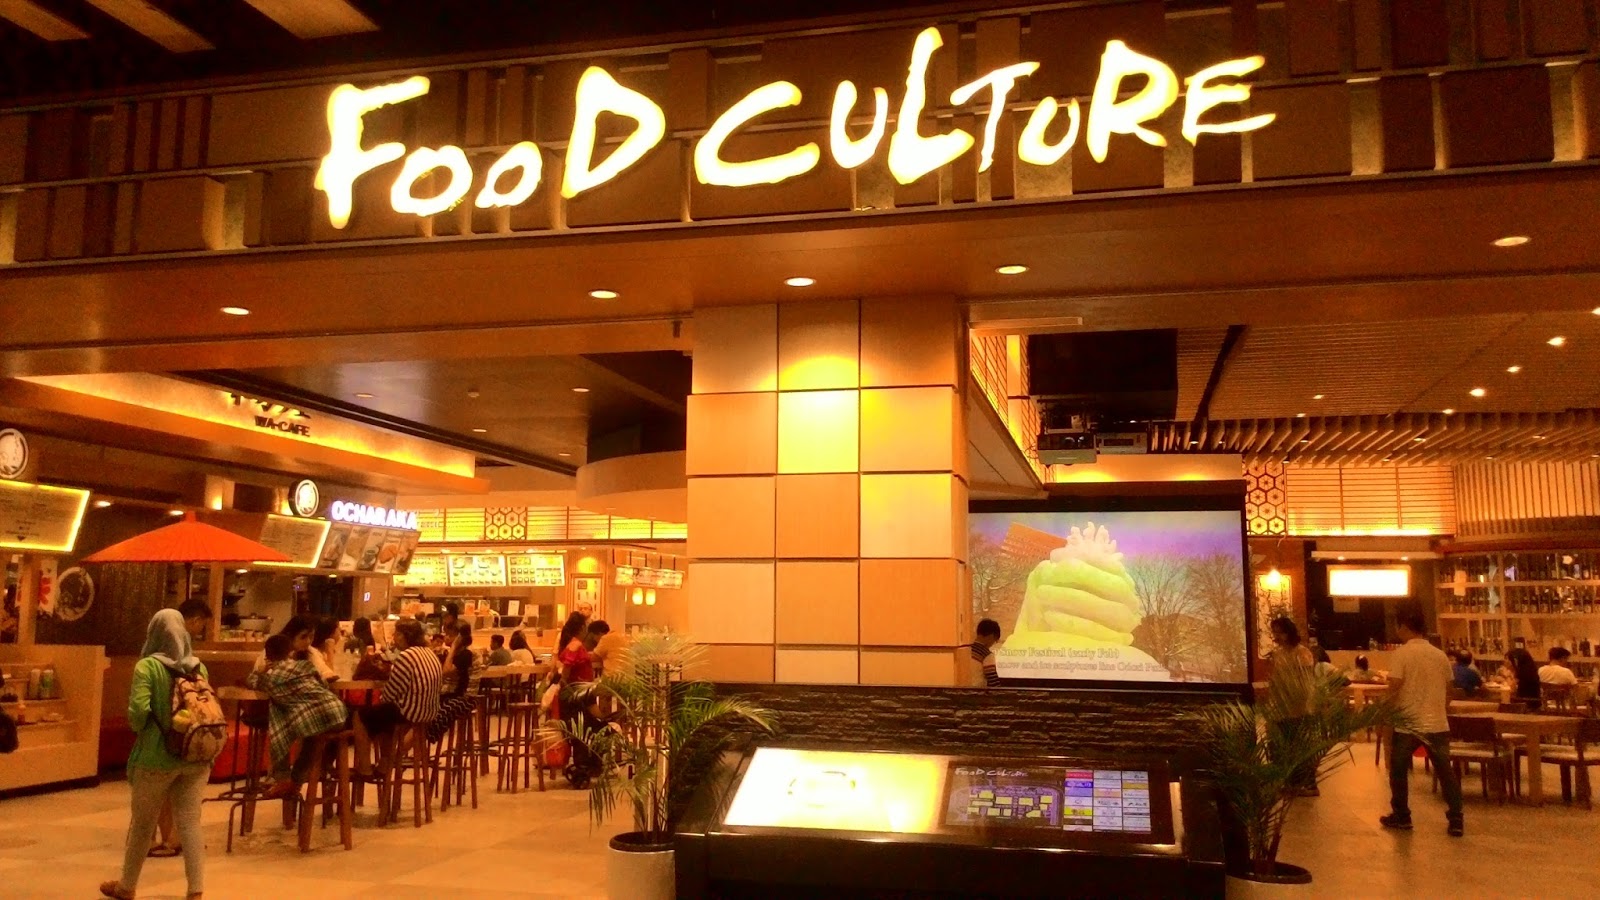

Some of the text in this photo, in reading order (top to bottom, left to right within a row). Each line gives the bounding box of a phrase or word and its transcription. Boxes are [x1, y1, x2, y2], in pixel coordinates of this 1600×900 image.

[254, 415, 311, 438] WA-CAFE
[331, 500, 417, 530] OCHARAKA
[1028, 646, 1066, 658] Festival
